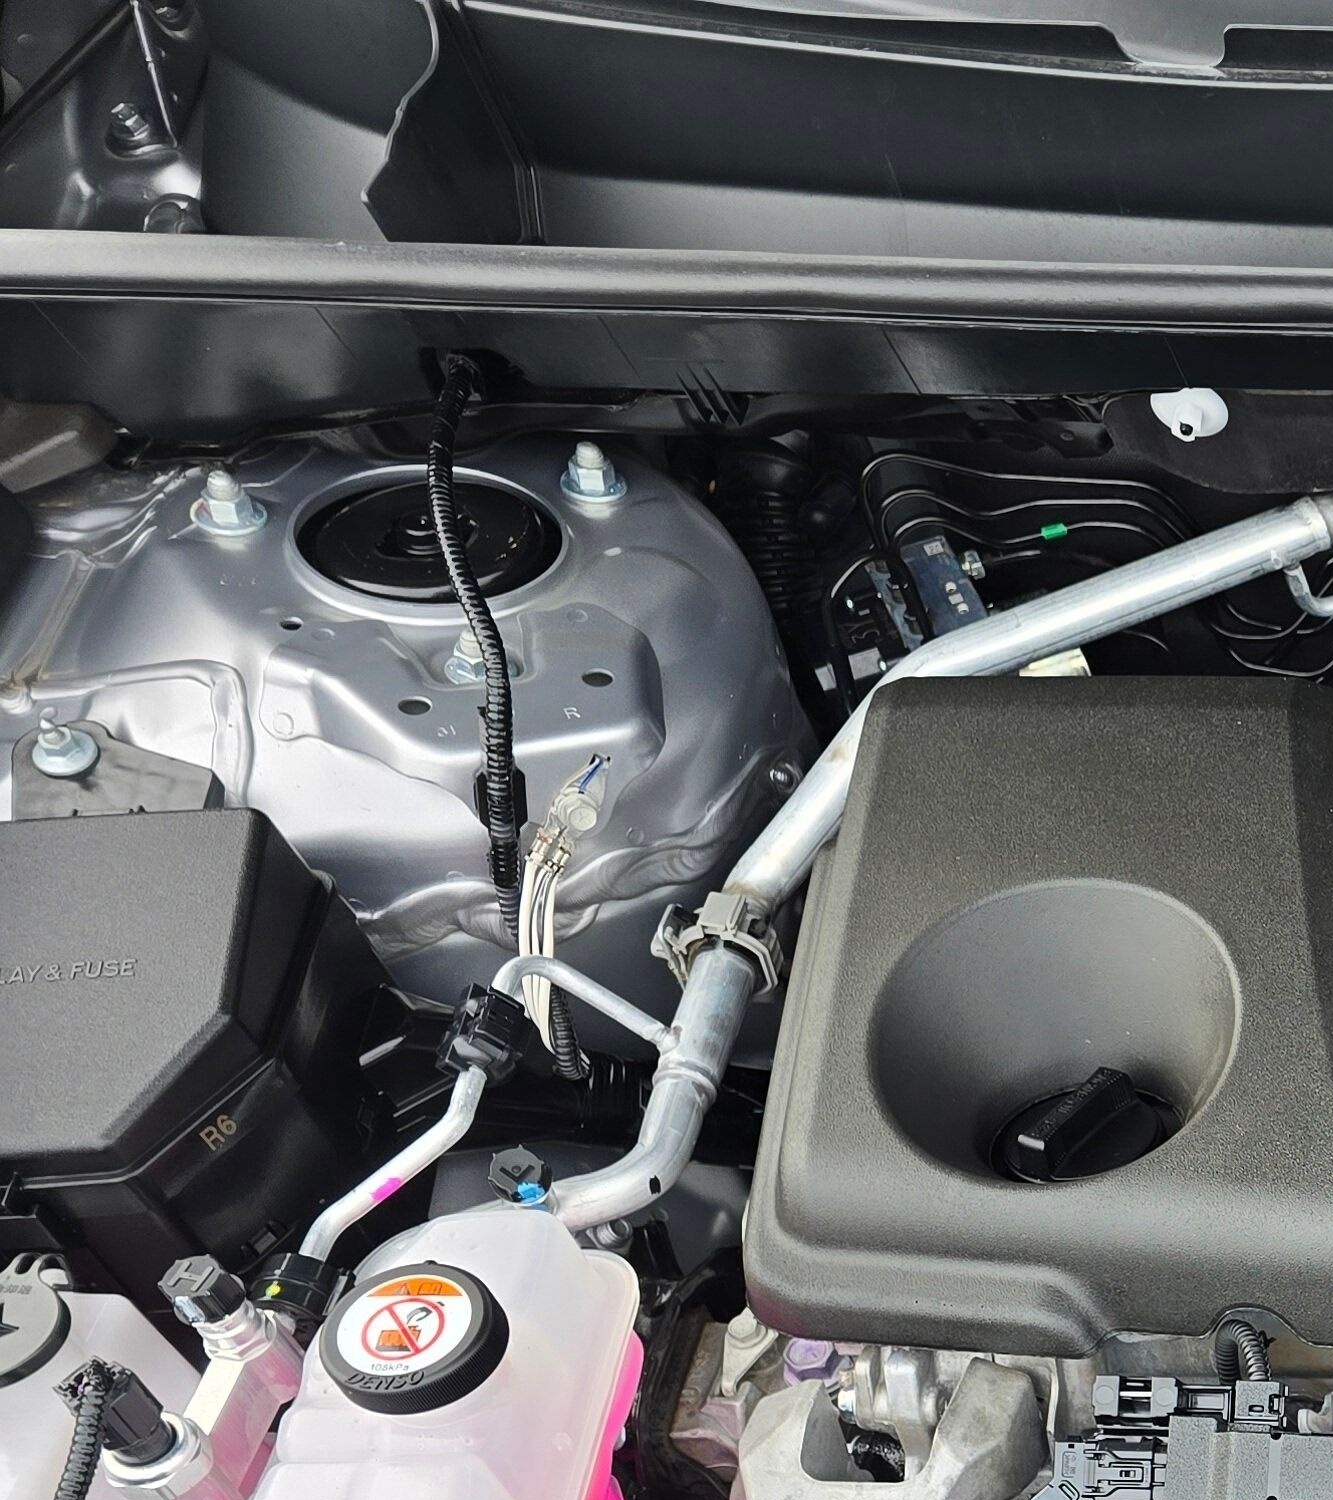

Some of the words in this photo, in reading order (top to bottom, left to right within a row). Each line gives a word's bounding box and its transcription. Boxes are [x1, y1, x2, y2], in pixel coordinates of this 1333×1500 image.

[44, 964, 62, 981] &
[69, 958, 138, 981] FUSE
[200, 1115, 238, 1151] R6
[168, 1260, 215, 1292] H
[346, 1370, 425, 1391] DENSO
